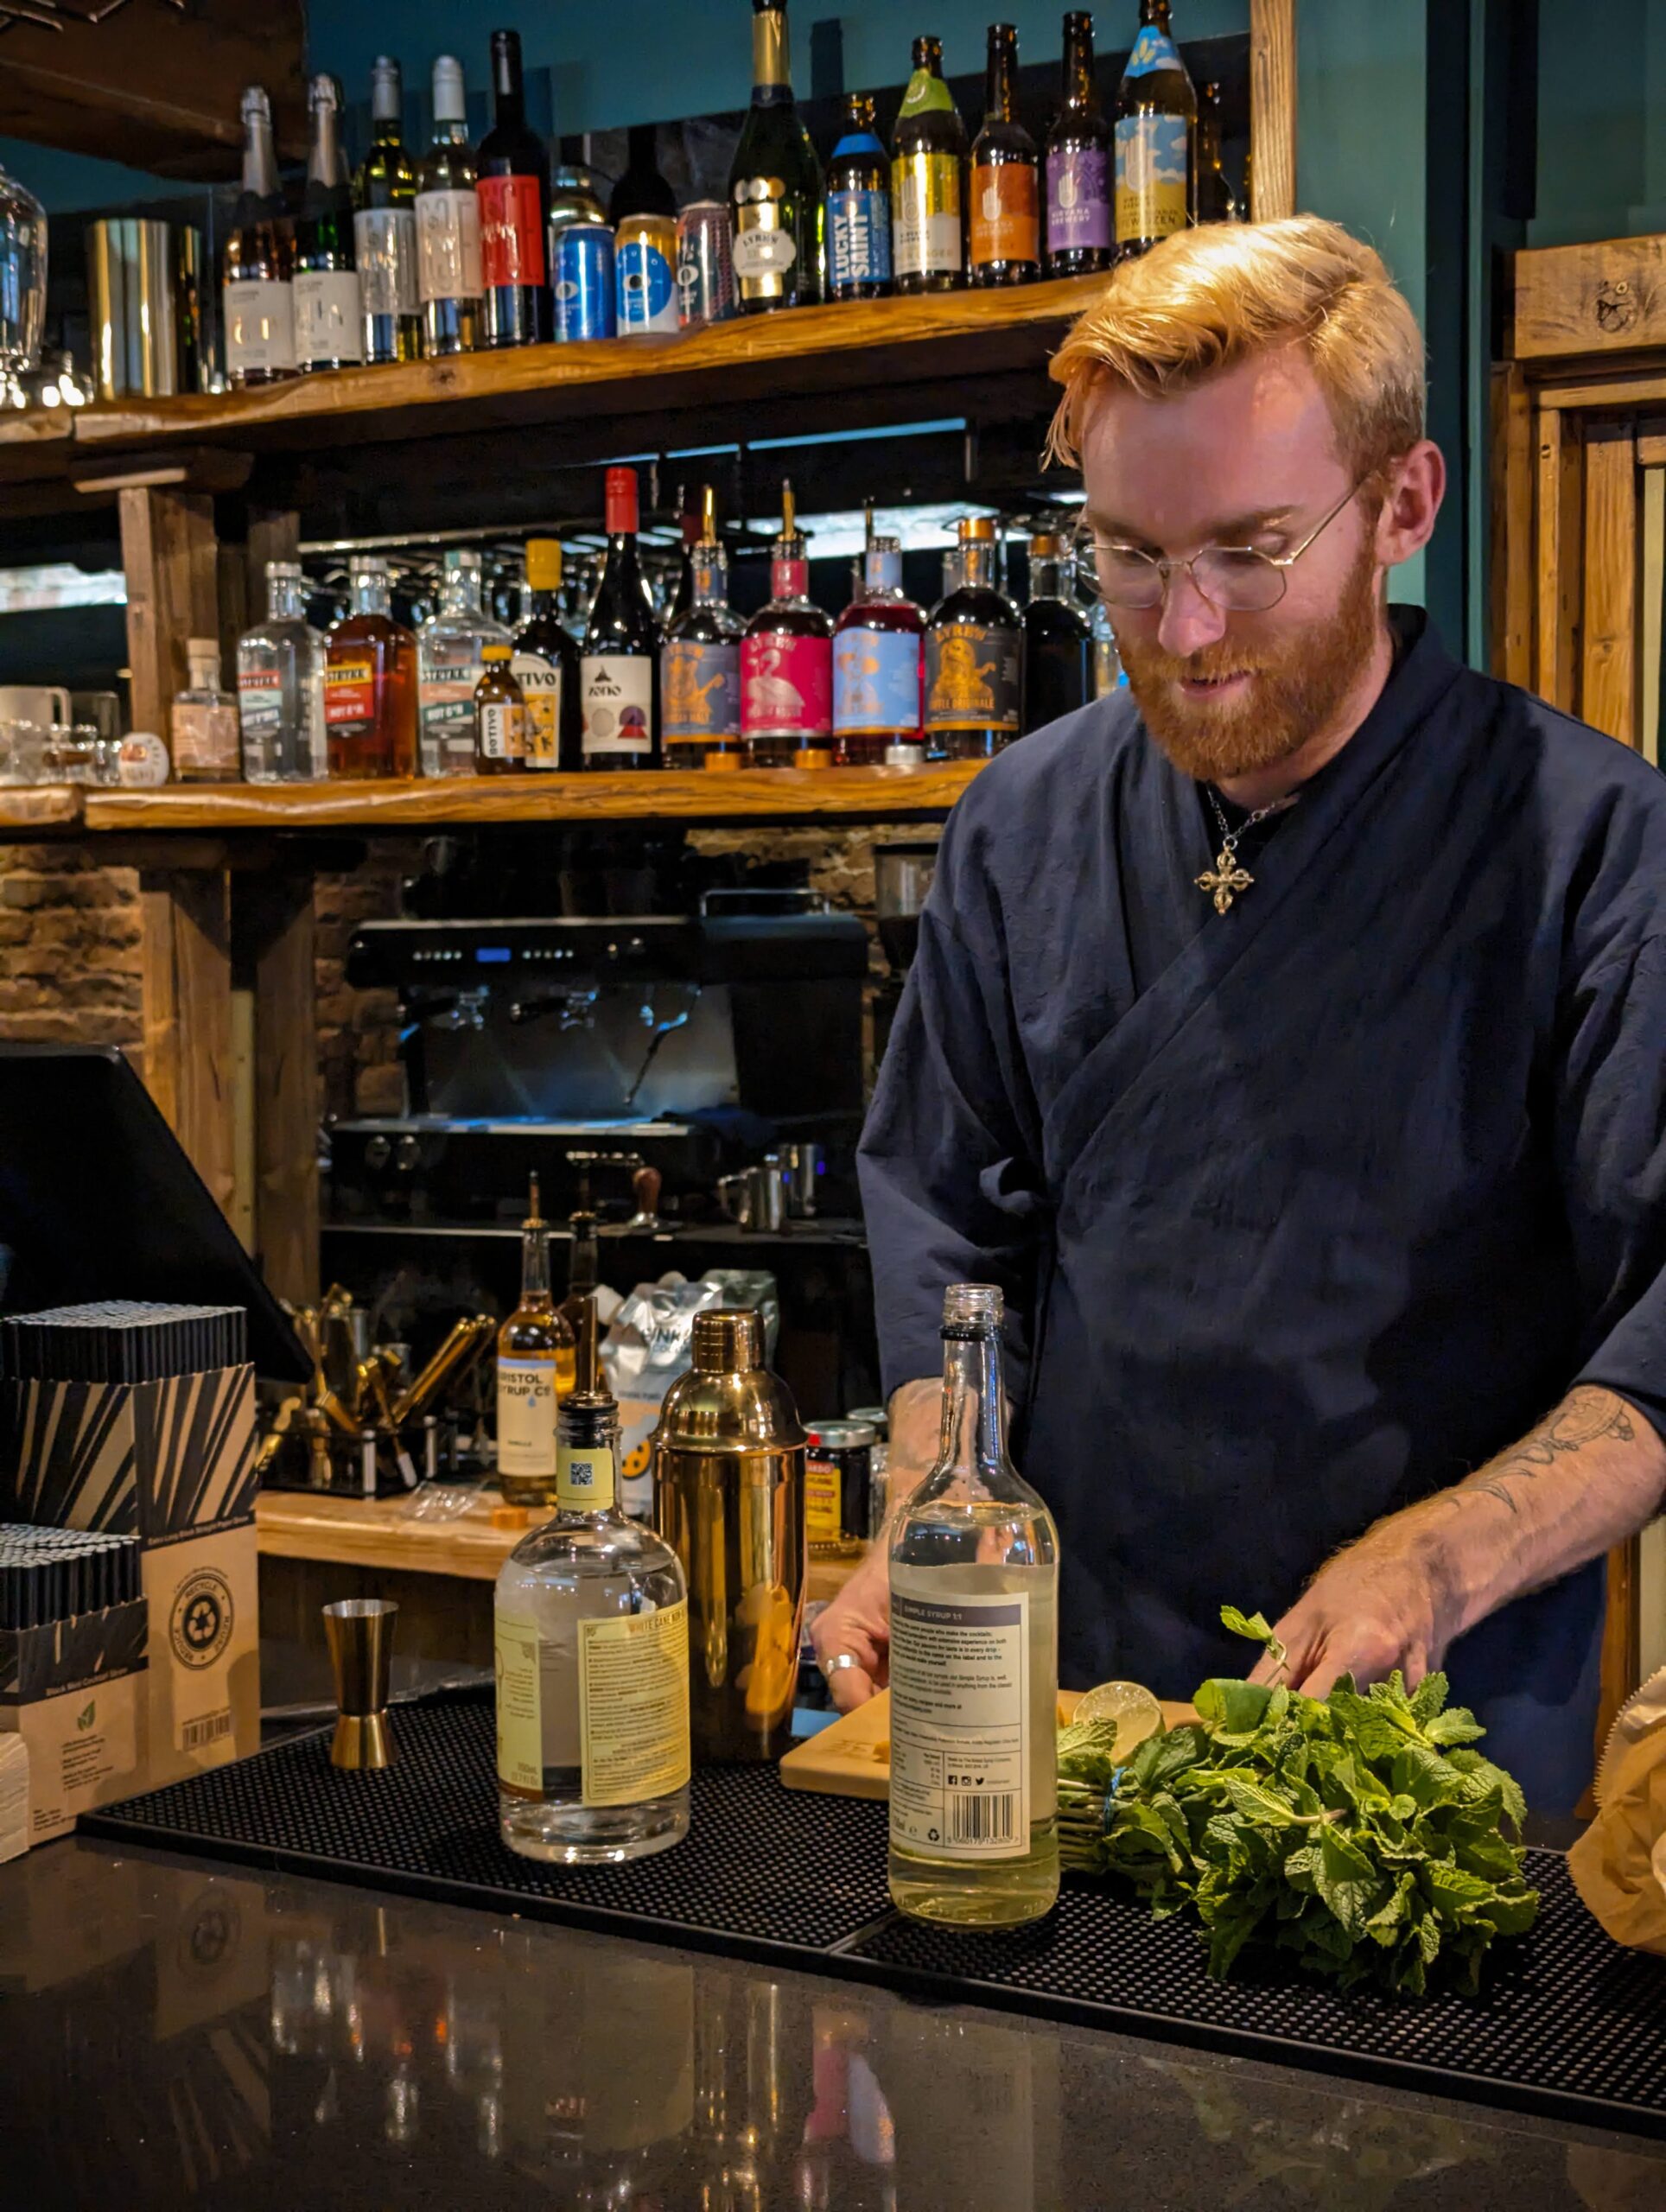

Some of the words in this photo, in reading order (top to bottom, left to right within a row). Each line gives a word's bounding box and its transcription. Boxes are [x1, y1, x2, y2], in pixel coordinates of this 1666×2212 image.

[834, 215, 849, 280] LUCKY
[849, 215, 870, 277] SAINT
[184, 1580, 217, 1599] RECYCLE
[904, 1605, 925, 1617] SIMPLE
[927, 1610, 951, 1619] SYRUP
